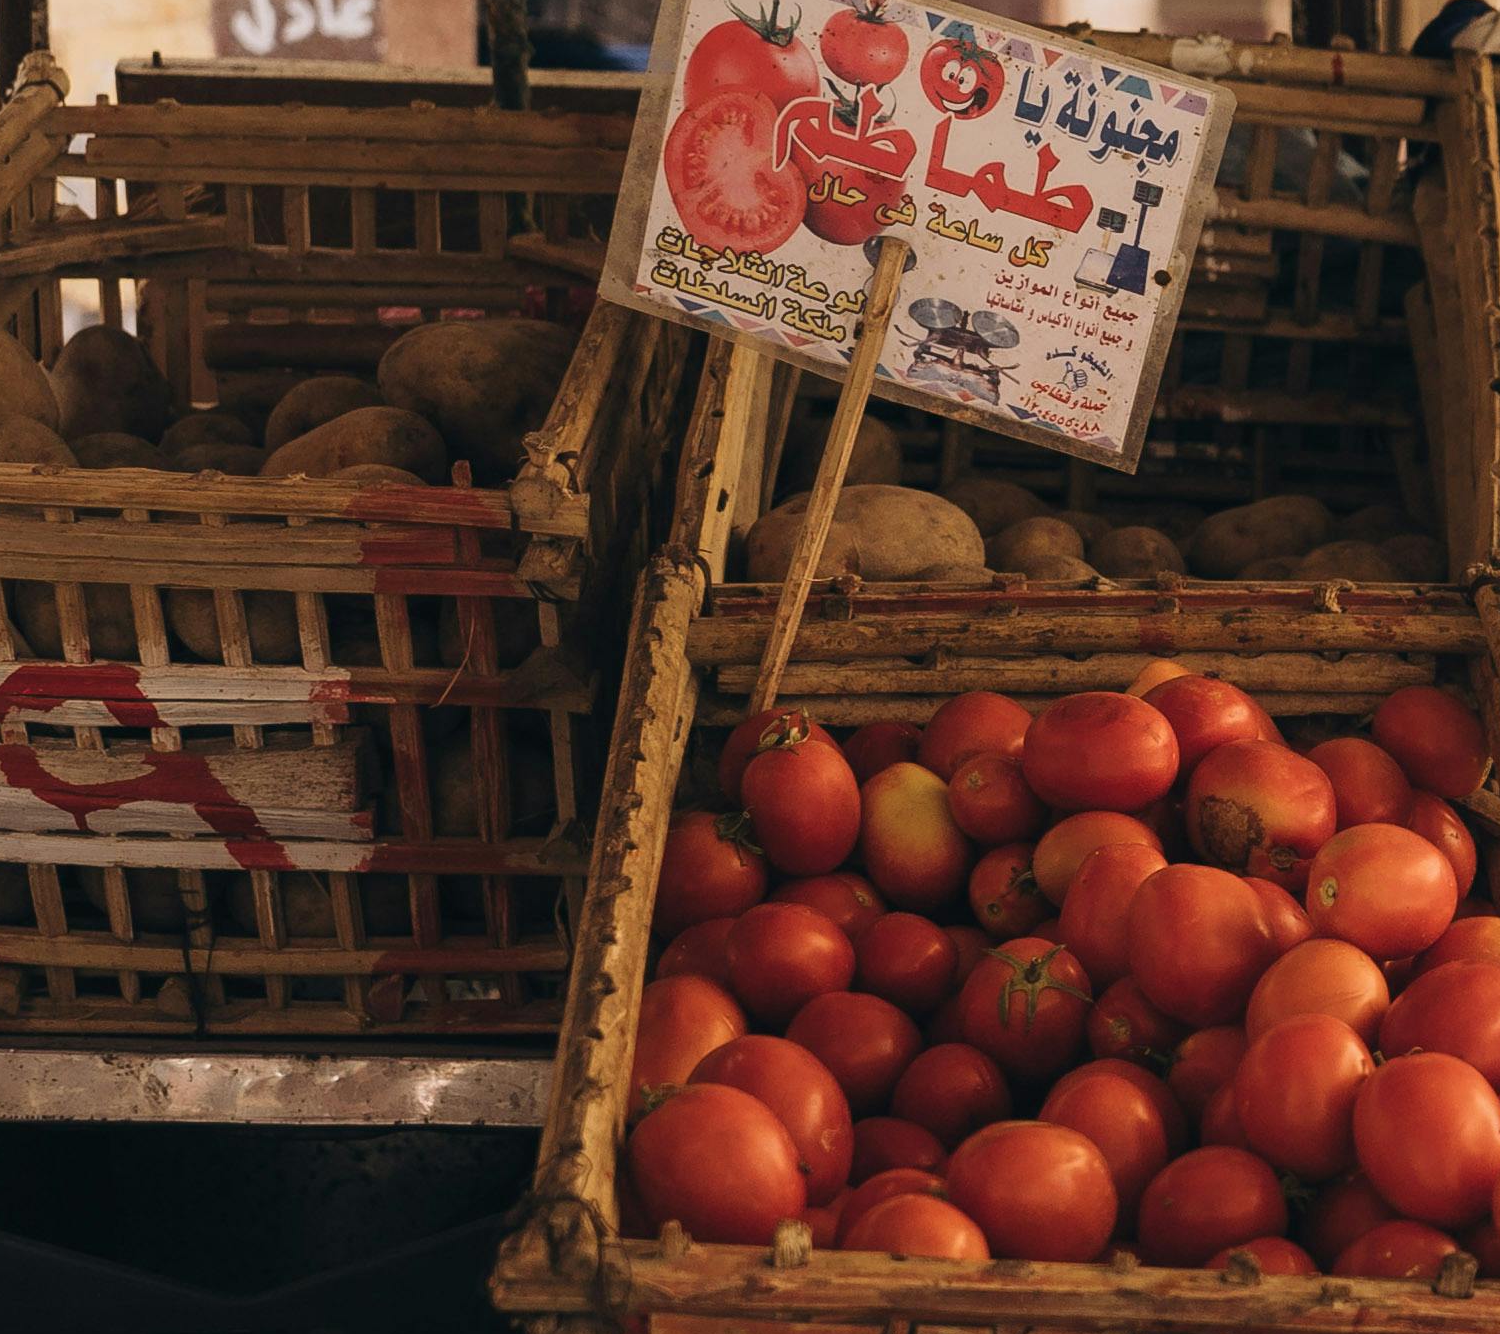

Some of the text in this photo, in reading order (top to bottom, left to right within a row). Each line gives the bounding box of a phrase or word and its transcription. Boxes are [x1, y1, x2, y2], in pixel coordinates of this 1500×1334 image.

[1014, 67, 1181, 175] مجنونة يا
[773, 84, 1094, 233] طماطم
[809, 172, 867, 204] حال
[927, 201, 1003, 255] ساعة
[1008, 236, 1053, 267] كل
[651, 259, 776, 320] السلطات
[656, 226, 868, 315] لوعة الثلاجات
[995, 270, 1139, 326] جميع أنواع الموازين
[781, 298, 847, 343] ملكة
[1099, 329, 1123, 348] جميع
